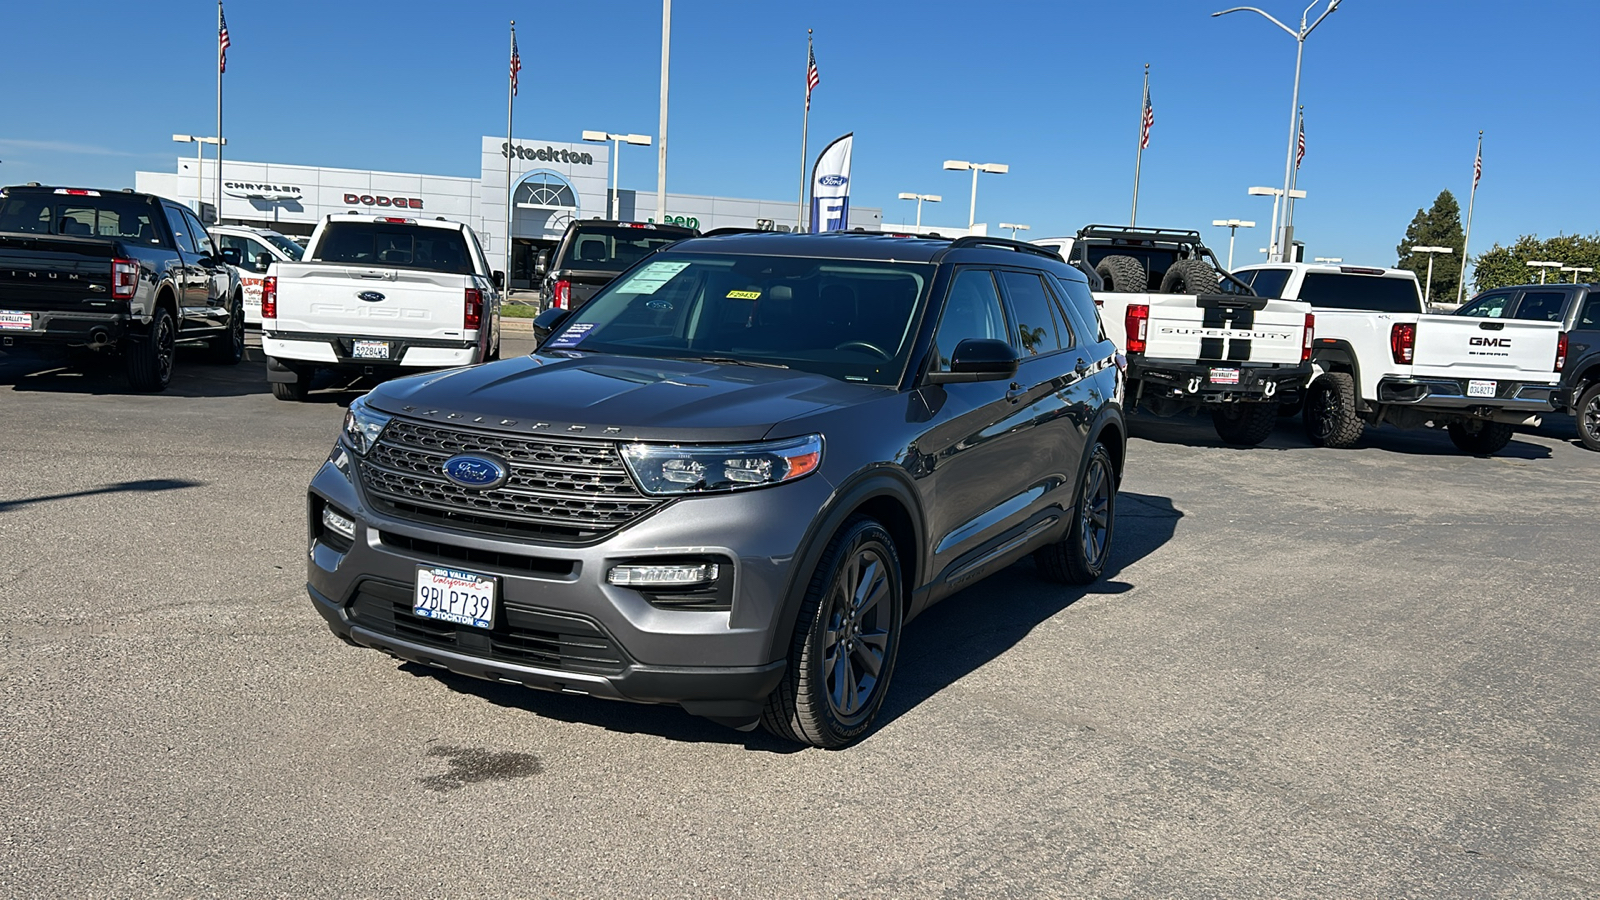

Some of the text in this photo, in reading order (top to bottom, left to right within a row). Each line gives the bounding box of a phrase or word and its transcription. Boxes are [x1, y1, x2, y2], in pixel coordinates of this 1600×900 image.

[501, 142, 593, 165] Stockton
[224, 181, 301, 194] CHRYSLER
[822, 176, 843, 186] Ford
[343, 193, 424, 210] DODGE
[648, 214, 700, 230] eep
[310, 302, 432, 321] F-150
[1161, 327, 1291, 340] SUPER DUTY
[1468, 337, 1512, 348] GMC
[433, 575, 482, 590] California
[434, 568, 477, 582] BIG VALLEY
[420, 586, 489, 619] 9BLP739
[430, 609, 475, 626] STOCKTON
